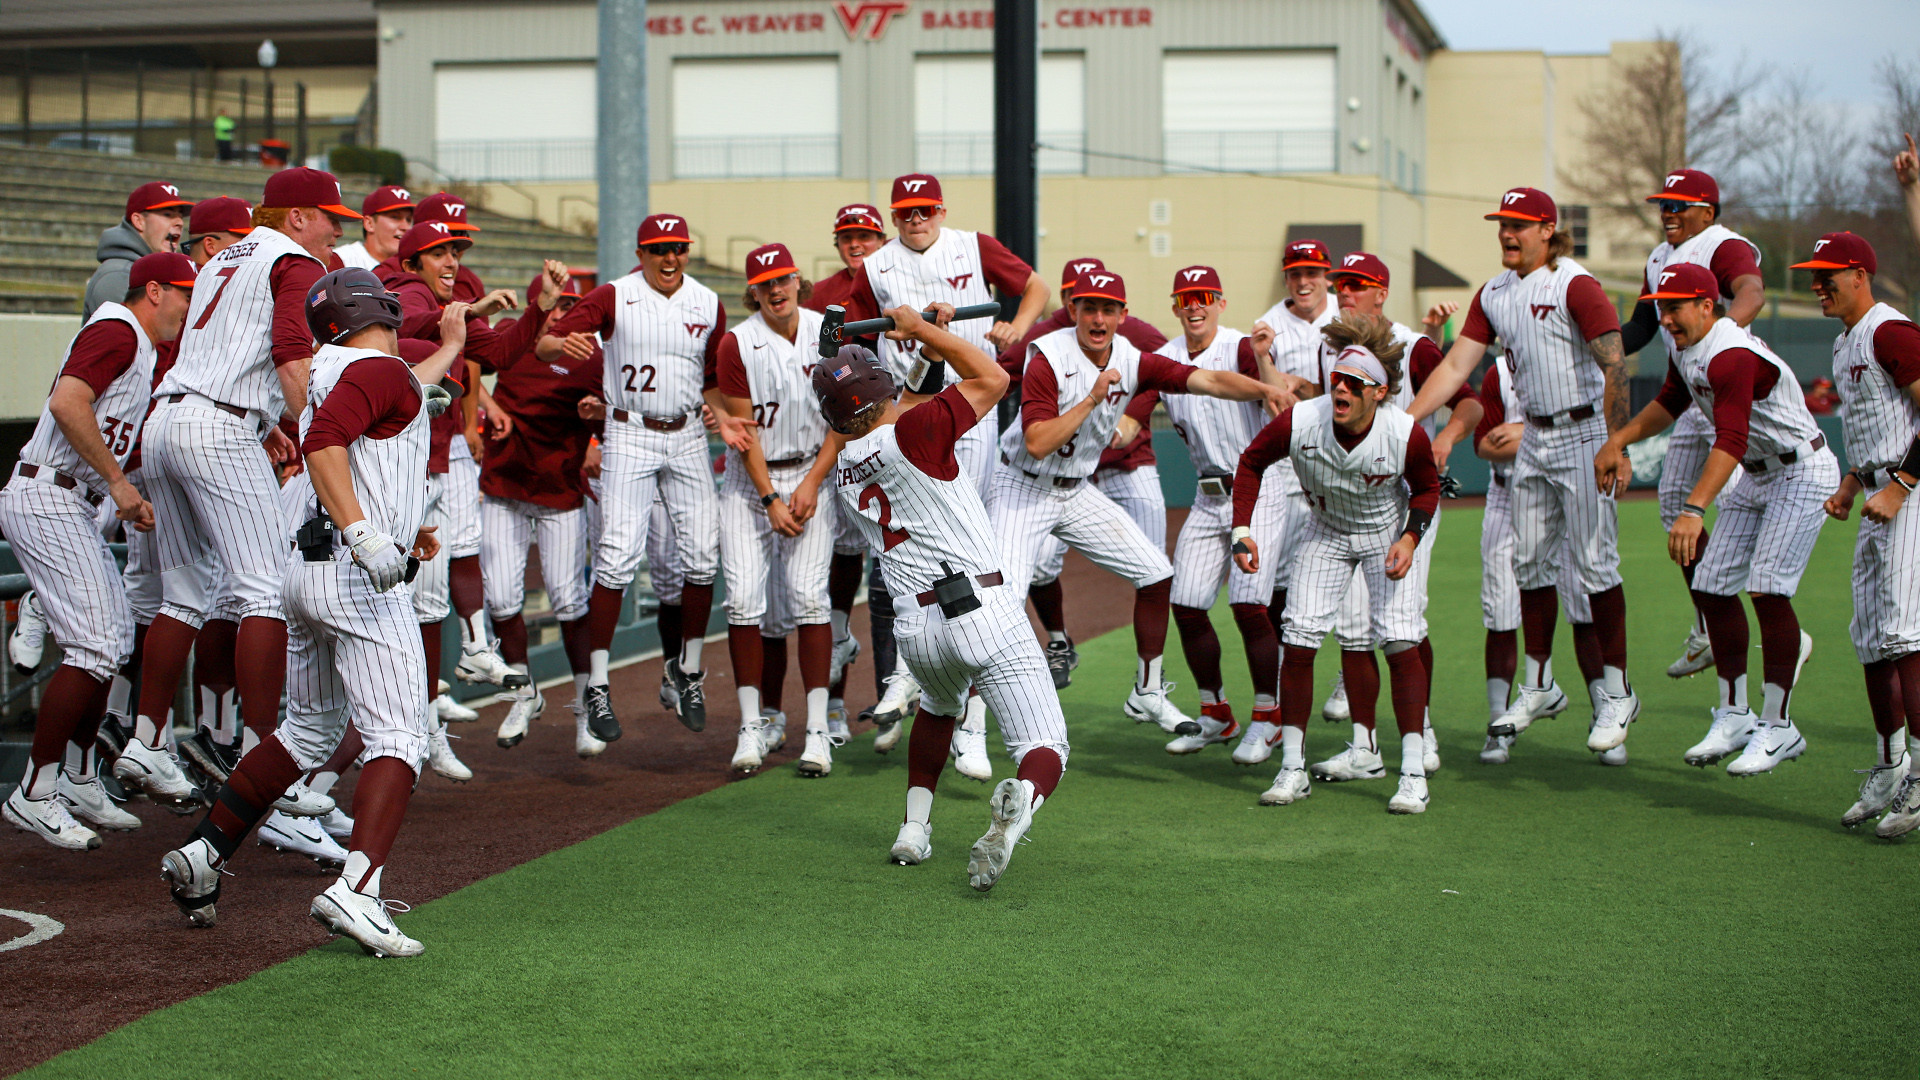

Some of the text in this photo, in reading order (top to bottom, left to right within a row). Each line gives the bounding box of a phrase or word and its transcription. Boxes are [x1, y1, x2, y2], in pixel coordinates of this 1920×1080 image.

[722, 13, 825, 34] WEAVER
[1055, 8, 1153, 28] CENTER
[834, 0, 909, 39] VT
[160, 185, 180, 197] VT
[903, 180, 927, 193] VT
[390, 188, 411, 200] VT
[1504, 192, 1527, 205] VT
[443, 203, 465, 217] VT
[429, 222, 449, 233] VT
[656, 219, 680, 231] VT
[756, 250, 780, 266] VT
[946, 272, 974, 291] VT
[1089, 275, 1115, 288] VT
[1182, 270, 1208, 282] VT
[191, 266, 240, 330] 7
[1531, 303, 1557, 320] VT
[329, 322, 339, 334] 5
[684, 323, 709, 339] VT
[621, 364, 657, 392] 22
[851, 395, 862, 406] 2
[102, 415, 134, 456] 35
[1361, 473, 1395, 488] VT
[858, 482, 912, 554] 2
